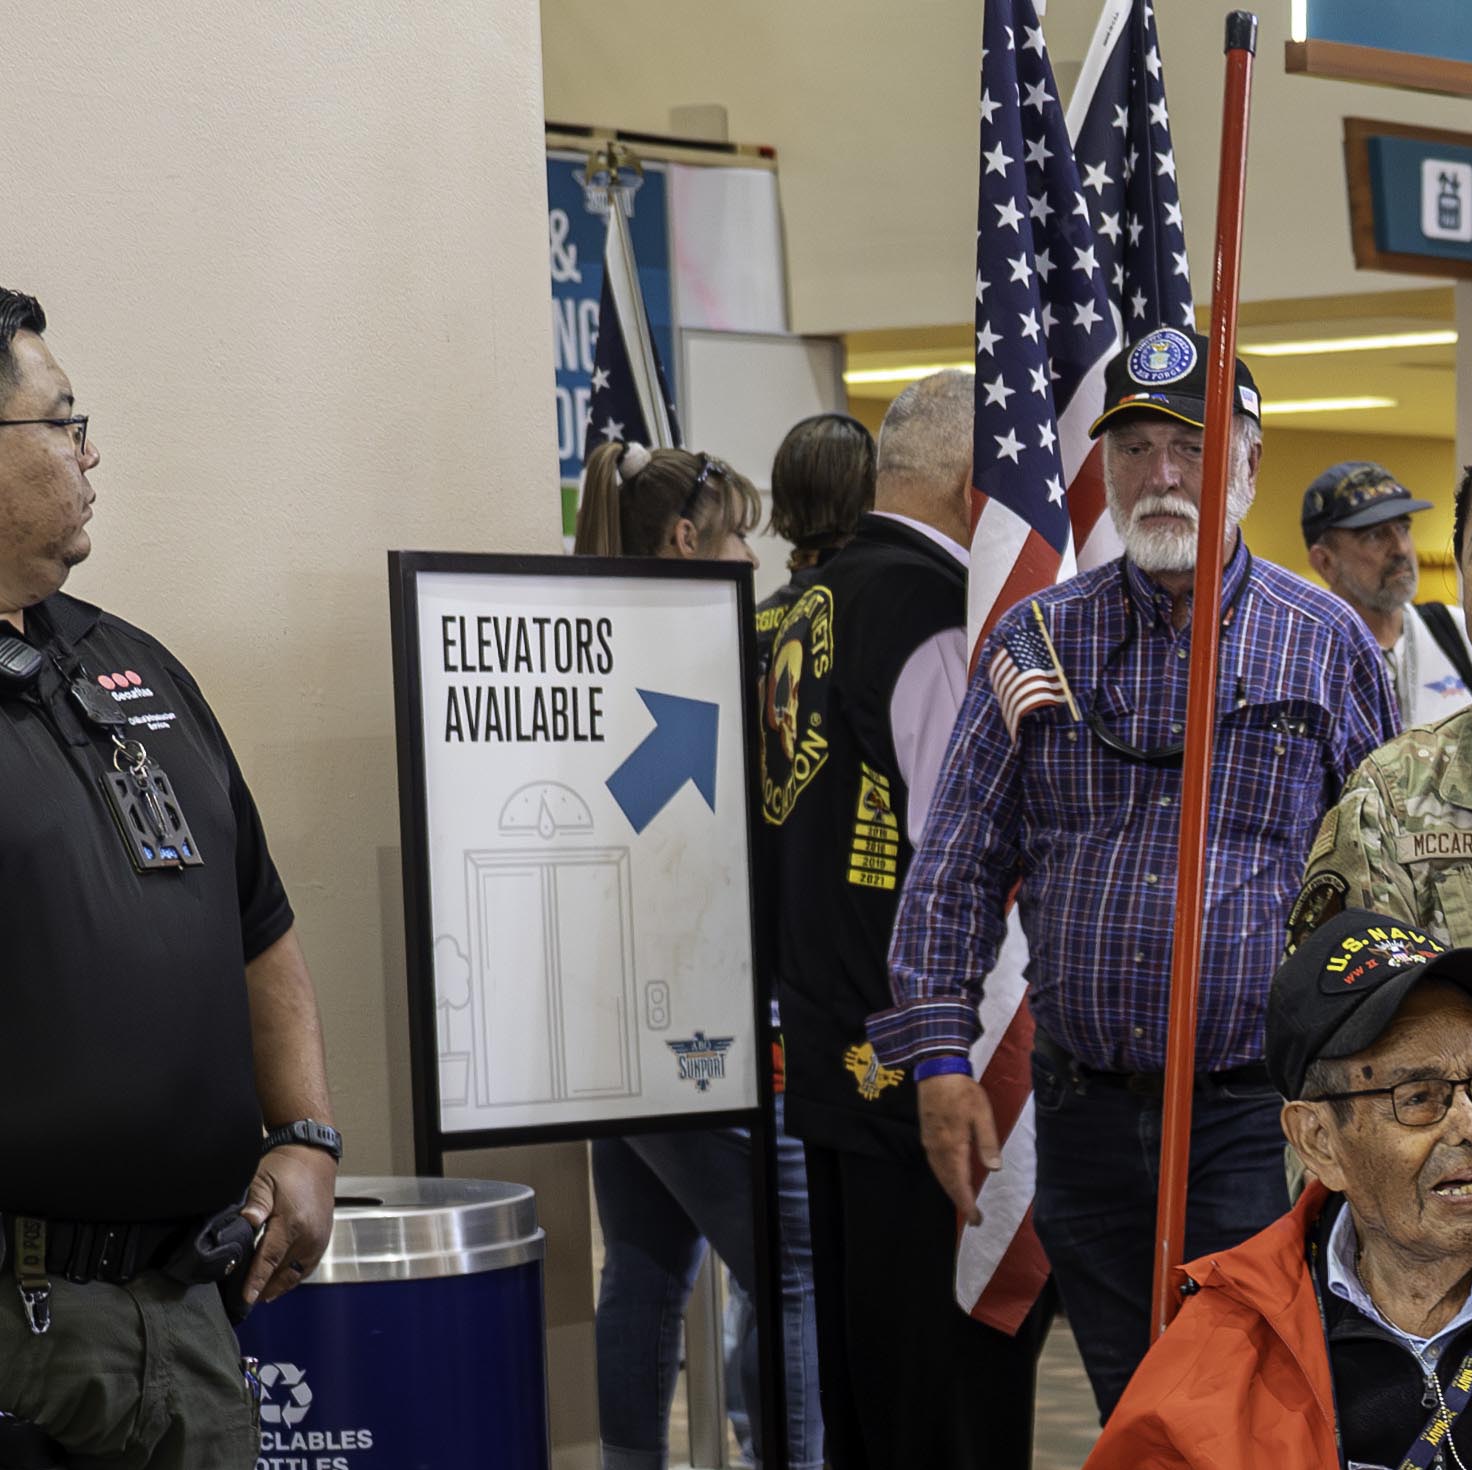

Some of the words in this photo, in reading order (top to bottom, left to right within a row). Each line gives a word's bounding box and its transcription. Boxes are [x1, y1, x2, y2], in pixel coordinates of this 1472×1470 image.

[552, 299, 600, 372] NG
[442, 616, 613, 674] ELEVATORS
[445, 686, 605, 742] AVAILABLE
[860, 872, 885, 887] 2021
[1326, 937, 1370, 973] U.S.
[1366, 926, 1445, 953] NAVY
[1343, 965, 1365, 985] WW
[679, 1054, 725, 1080] SUNPORT
[260, 1429, 373, 1451] CLABLES
[1425, 1418, 1450, 1448] NAVY
